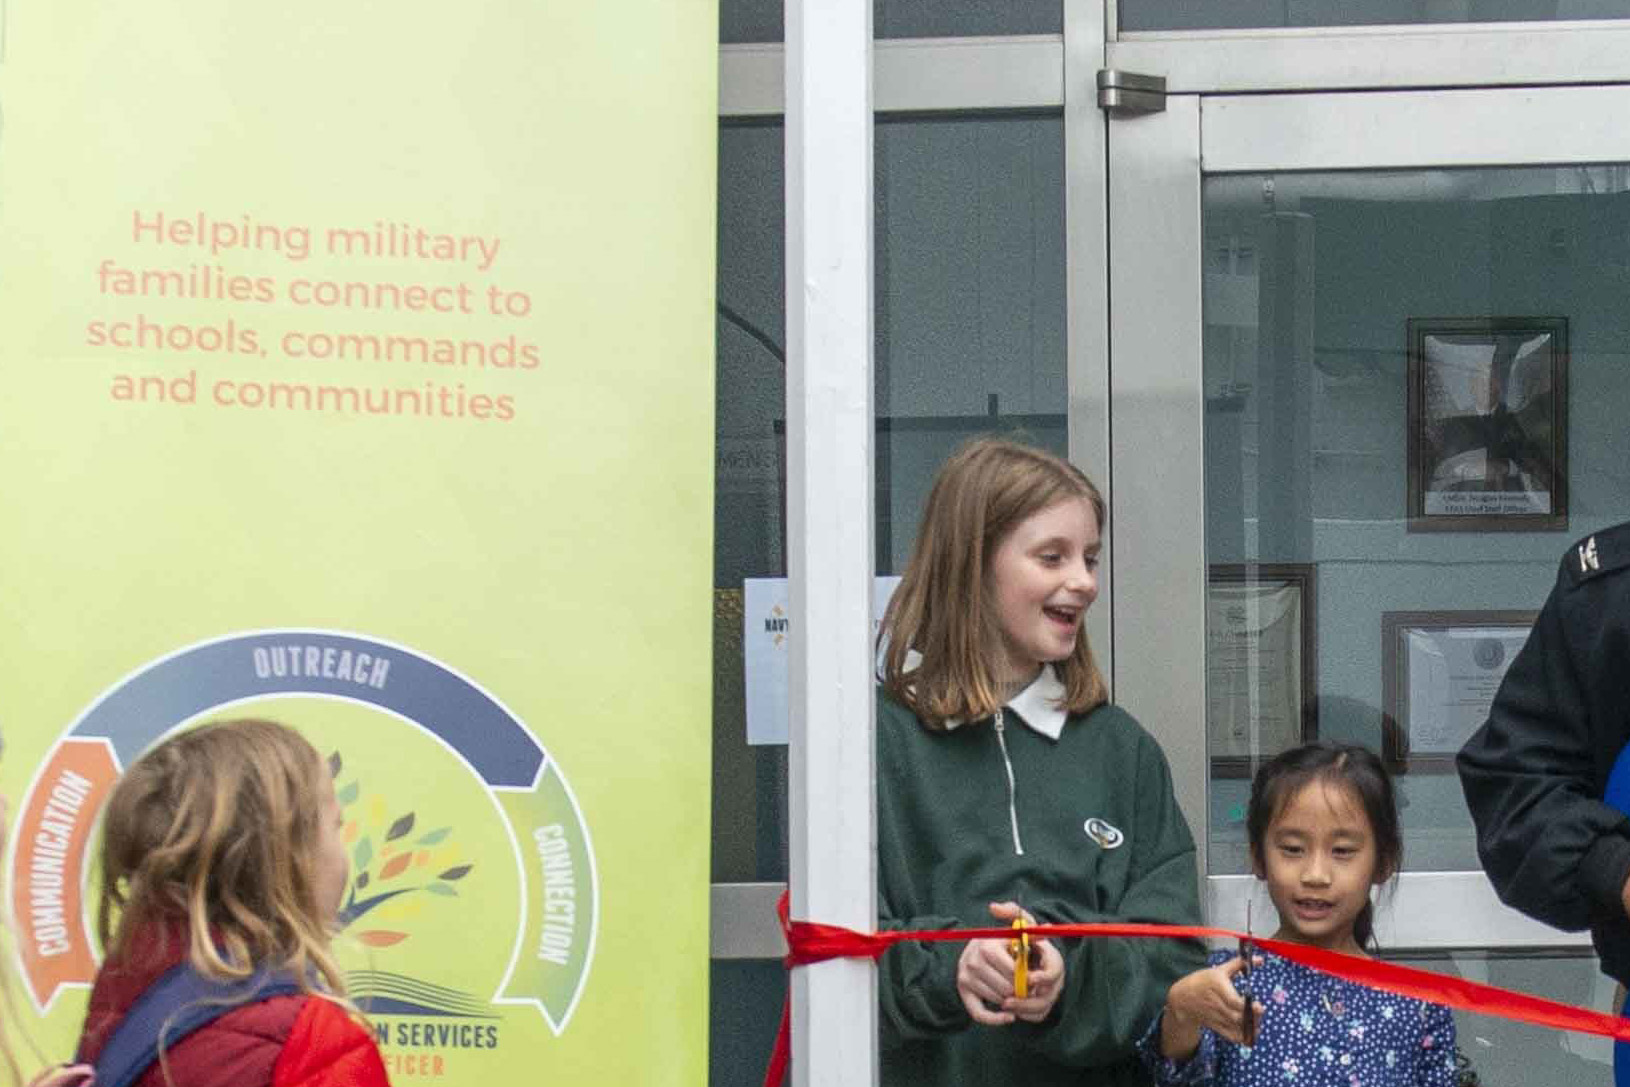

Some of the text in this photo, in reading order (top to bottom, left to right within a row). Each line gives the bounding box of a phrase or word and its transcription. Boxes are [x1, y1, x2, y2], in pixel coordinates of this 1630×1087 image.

[132, 209, 502, 272] Helping military
[96, 260, 533, 318] families connect to
[86, 313, 541, 371] schools, commands
[110, 369, 516, 422] and communities
[252, 645, 391, 690] OUTREACH
[30, 768, 93, 957] COMMUNICATION
[532, 822, 576, 966] CONNECTION
[396, 1022, 498, 1049] SERVICES
[383, 1054, 444, 1077] FICER
